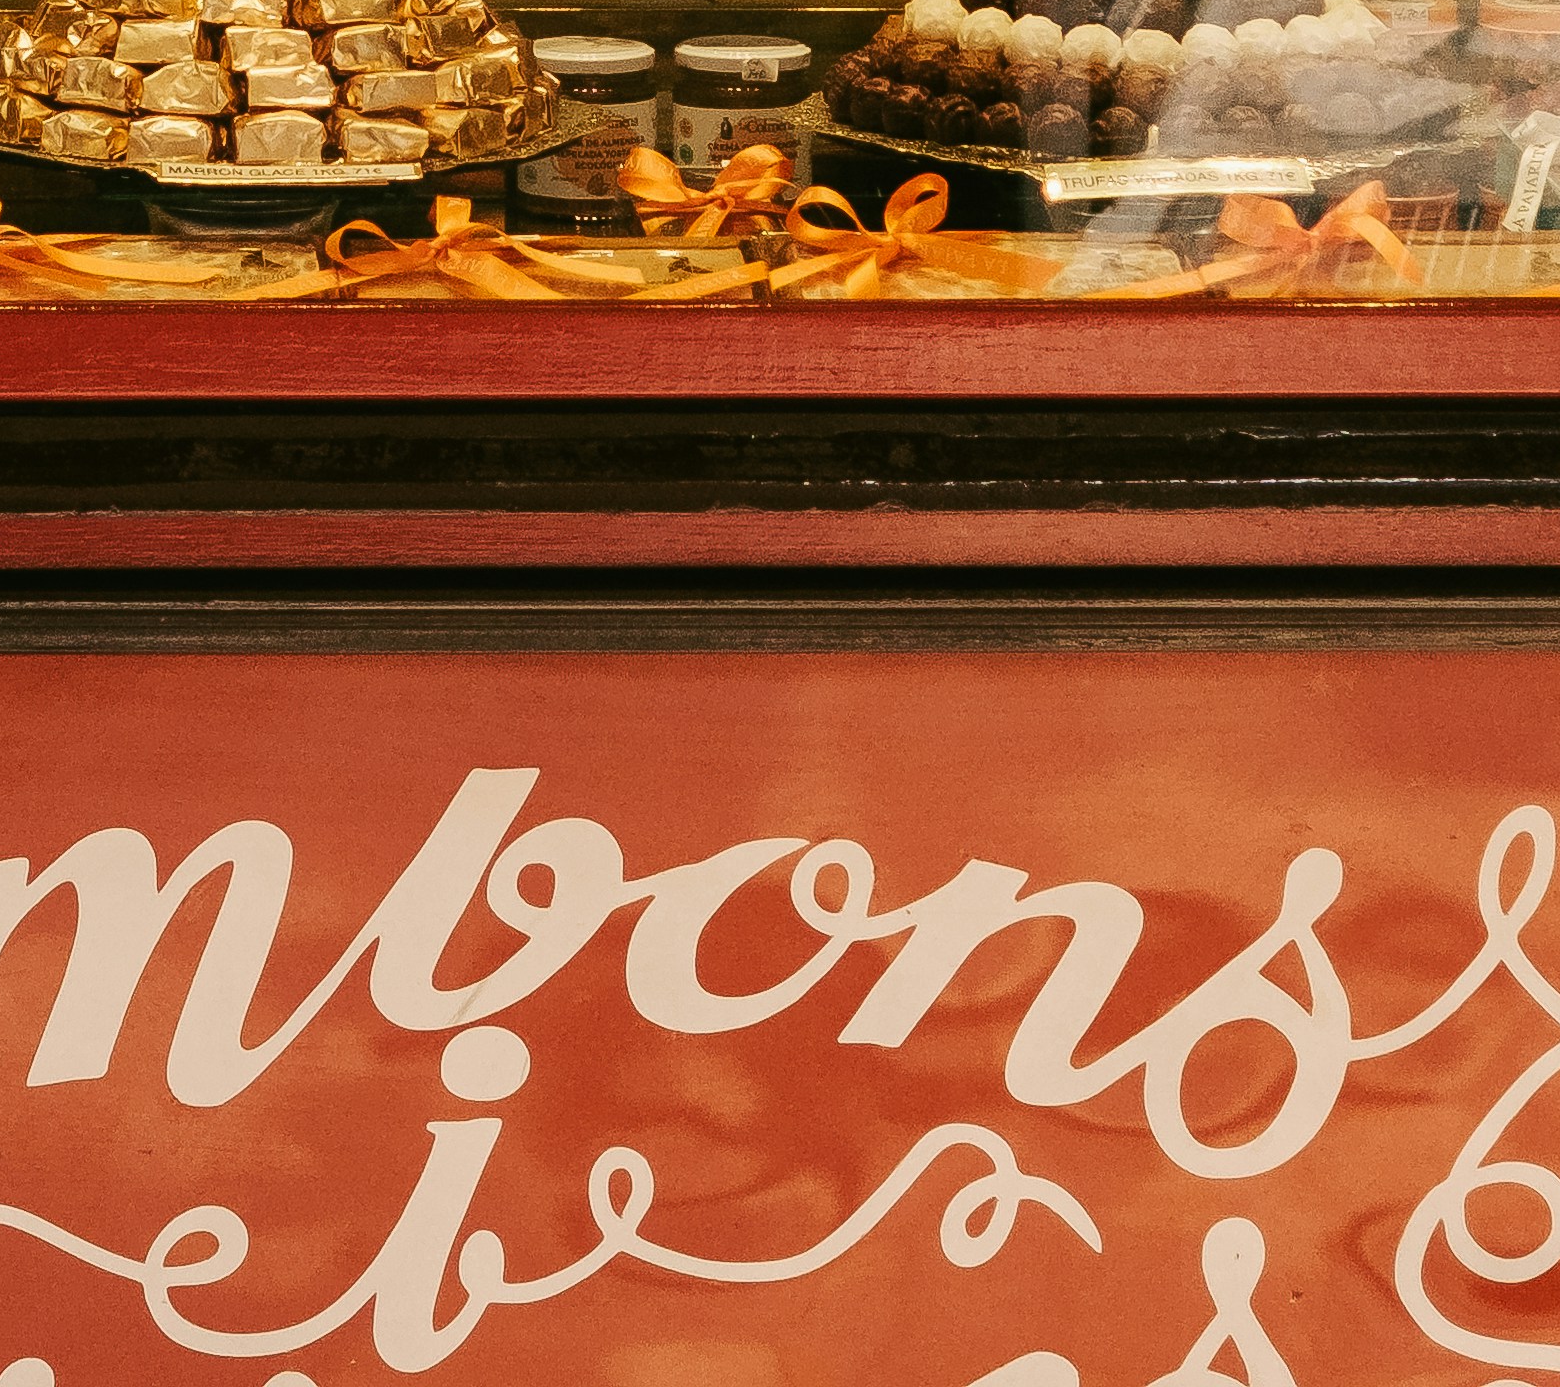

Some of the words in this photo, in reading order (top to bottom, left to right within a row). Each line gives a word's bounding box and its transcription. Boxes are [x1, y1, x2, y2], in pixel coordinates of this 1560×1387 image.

[168, 165, 243, 177] MARRON
[249, 168, 307, 177] GLACE
[1062, 176, 1128, 190] TRUFAS
